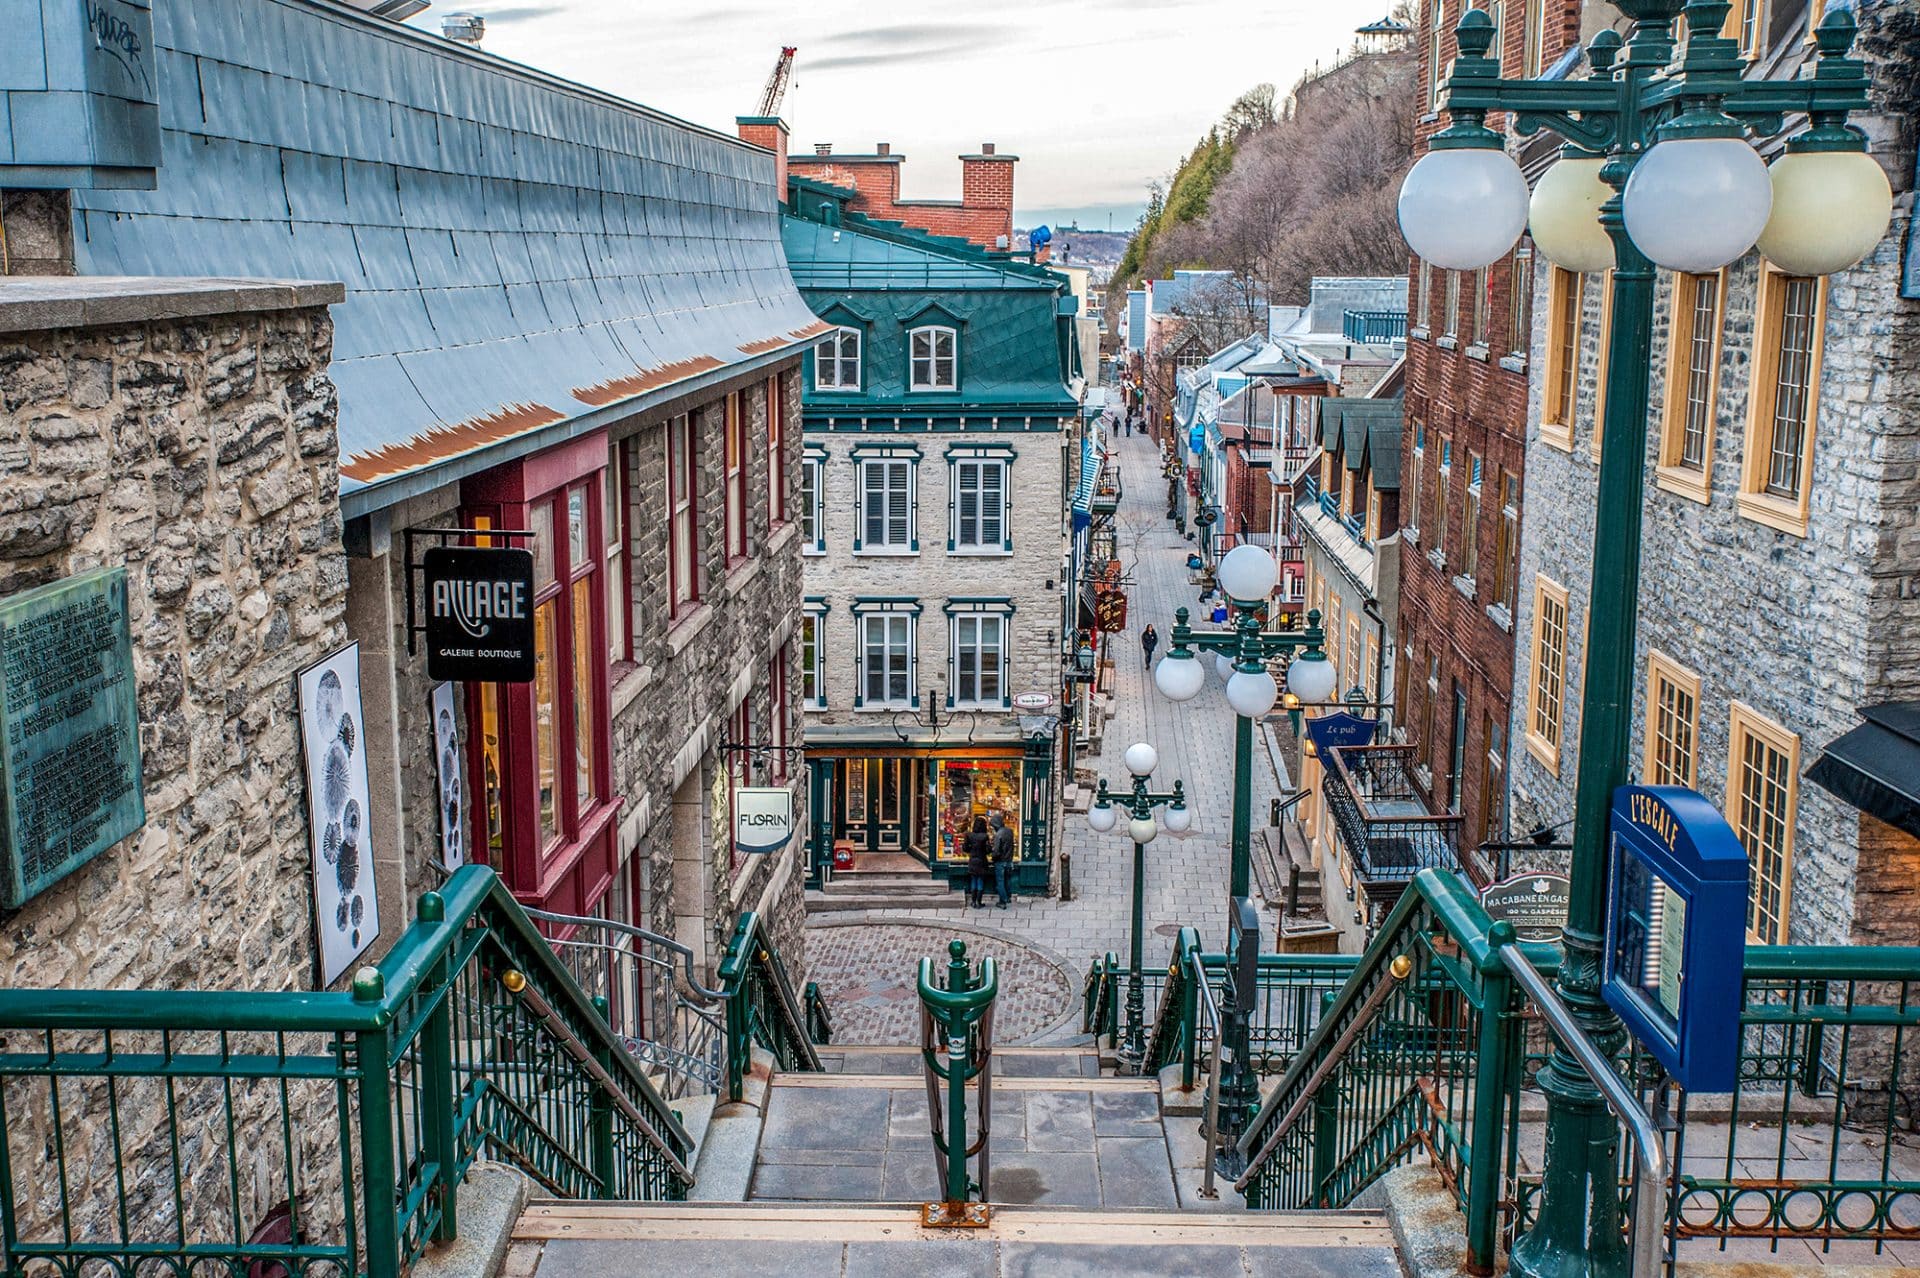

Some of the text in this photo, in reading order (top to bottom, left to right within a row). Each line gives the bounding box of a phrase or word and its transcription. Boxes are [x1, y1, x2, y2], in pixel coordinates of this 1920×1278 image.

[440, 648, 521, 658] GALERIE BOUTIQUE
[740, 814, 787, 826] FLORIN
[1631, 794, 1678, 852] L'ESCALE
[1488, 898, 1500, 907] MA
[1502, 896, 1537, 904] CABANE
